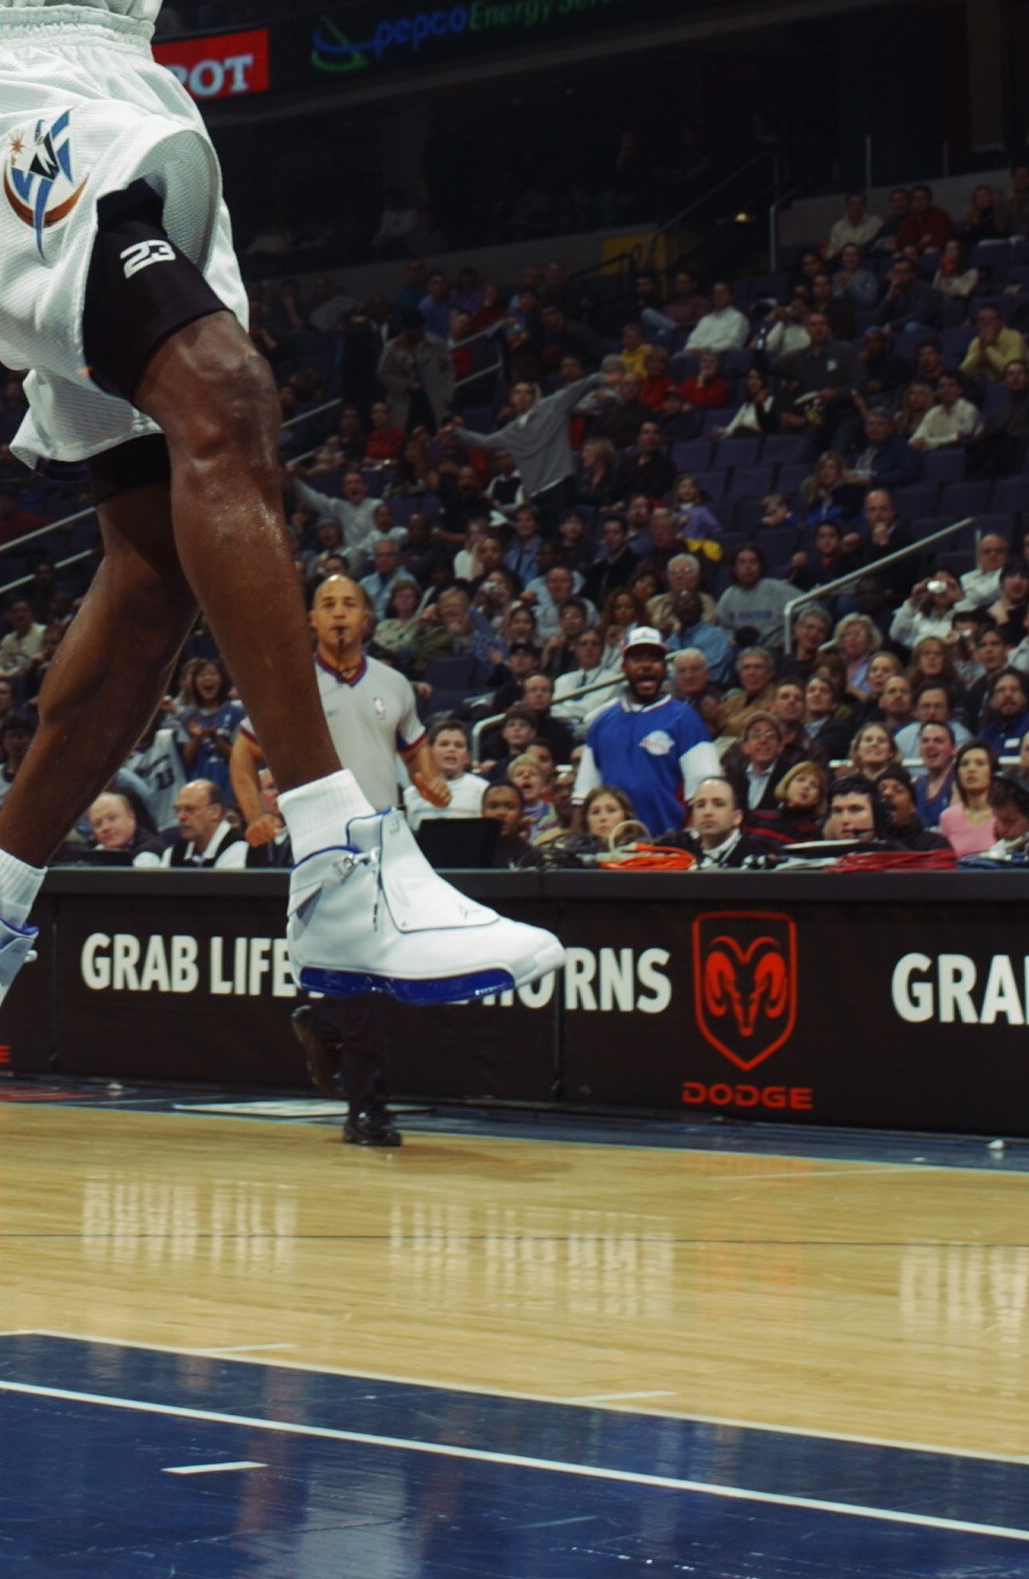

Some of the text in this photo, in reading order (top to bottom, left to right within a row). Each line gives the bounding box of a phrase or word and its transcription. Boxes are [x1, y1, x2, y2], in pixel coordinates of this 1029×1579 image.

[120, 239, 177, 279] 23
[81, 932, 200, 993] GRAB
[210, 936, 298, 997] LIFE
[891, 952, 1029, 1025] GRA
[682, 1082, 814, 1110] DODGE
